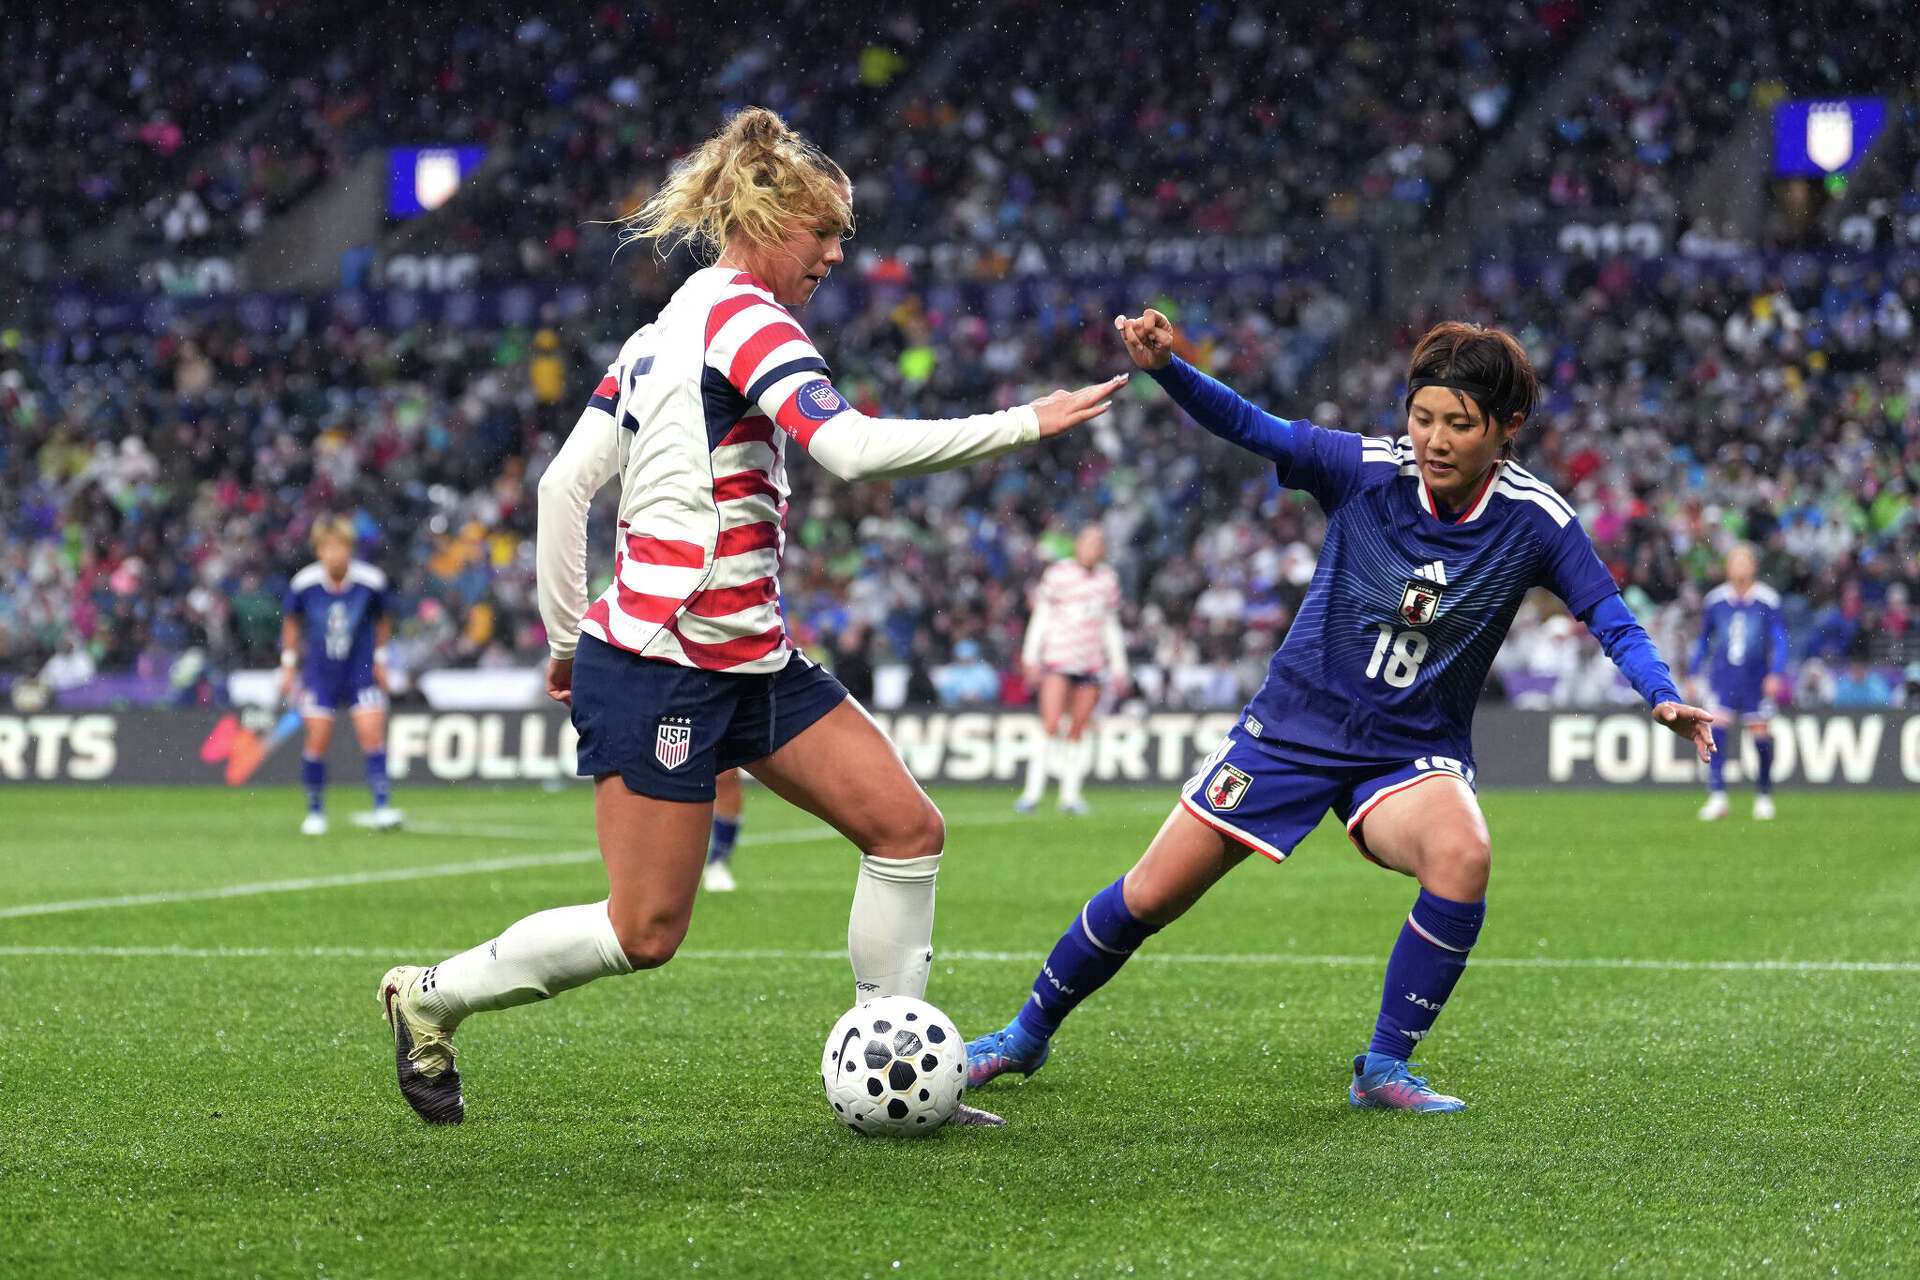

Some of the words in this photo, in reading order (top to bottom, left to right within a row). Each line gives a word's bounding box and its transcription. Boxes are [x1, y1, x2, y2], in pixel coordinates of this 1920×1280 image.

[811, 388, 831, 401] USA
[1365, 622, 1430, 689] 18
[660, 726, 689, 745] USA
